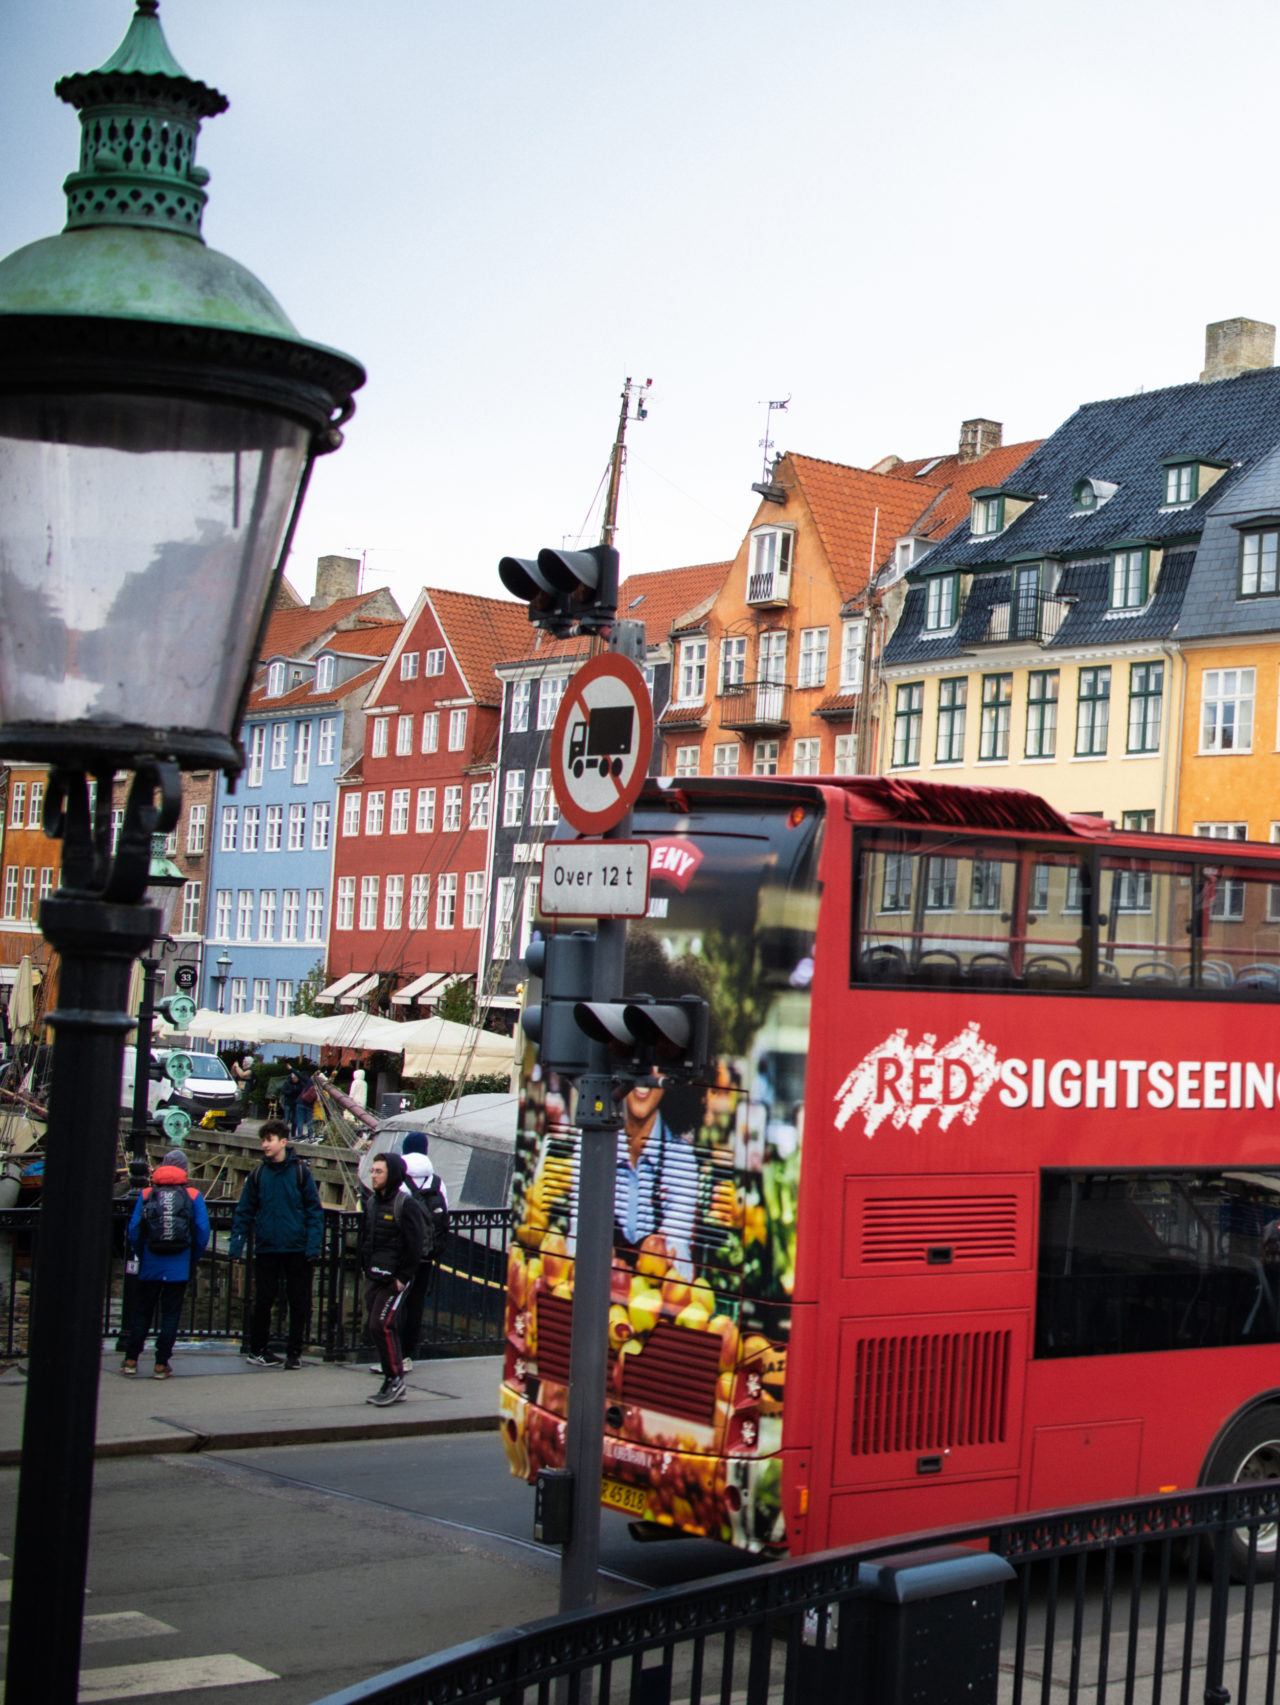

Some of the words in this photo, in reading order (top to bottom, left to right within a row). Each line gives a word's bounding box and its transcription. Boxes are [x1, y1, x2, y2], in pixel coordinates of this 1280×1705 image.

[554, 866, 592, 886] Over
[602, 866, 619, 886] 12
[626, 866, 633, 886] t
[181, 973, 192, 982] 33
[874, 1057, 975, 1106] RED
